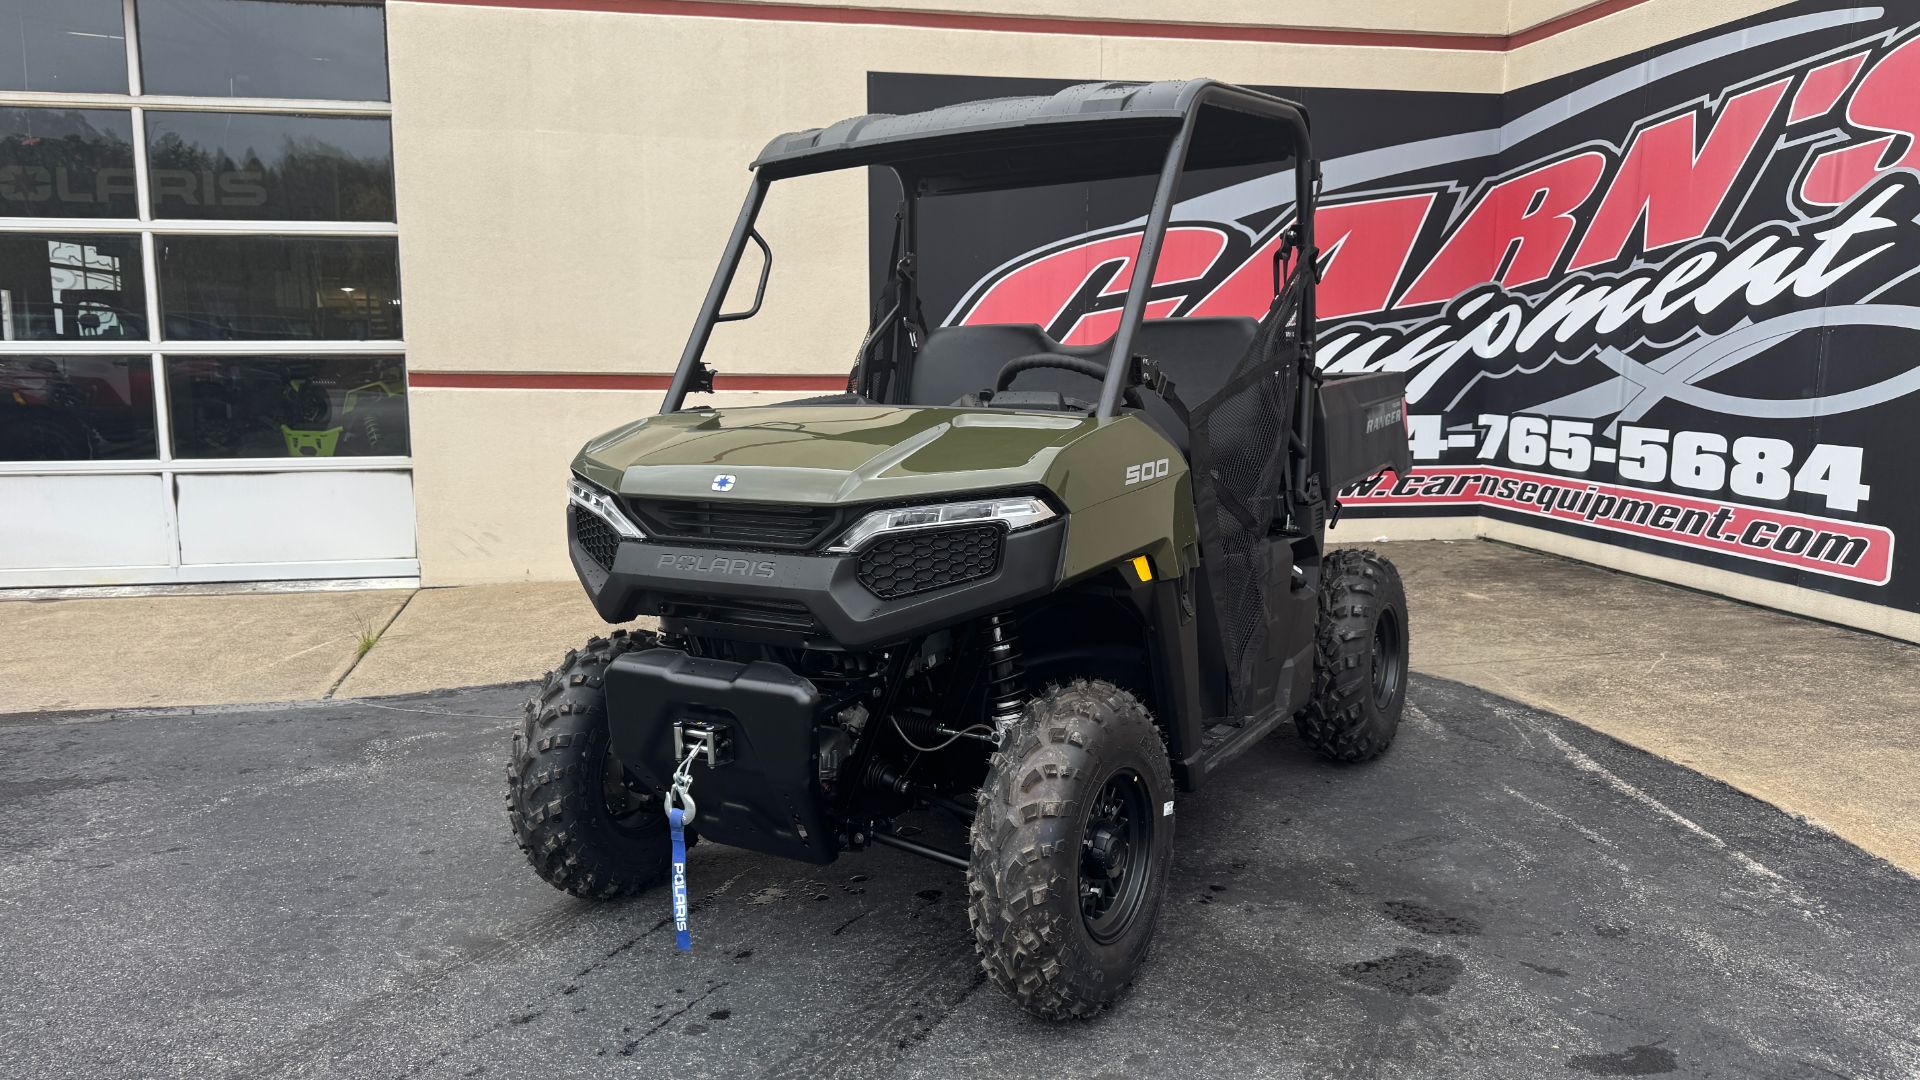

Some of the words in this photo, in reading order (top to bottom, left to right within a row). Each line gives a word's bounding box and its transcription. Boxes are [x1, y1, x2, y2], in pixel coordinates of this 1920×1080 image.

[0, 165, 267, 206] OLARIS
[1316, 184, 1905, 404] uipment
[1366, 409, 1401, 434] RANGER
[1125, 458, 1169, 485] 500
[1407, 413, 1870, 512] 4-765-5684
[1337, 471, 1870, 568] w.carnsequipment.com
[657, 553, 776, 578] POLARIS
[674, 862, 687, 932] POLARIS
